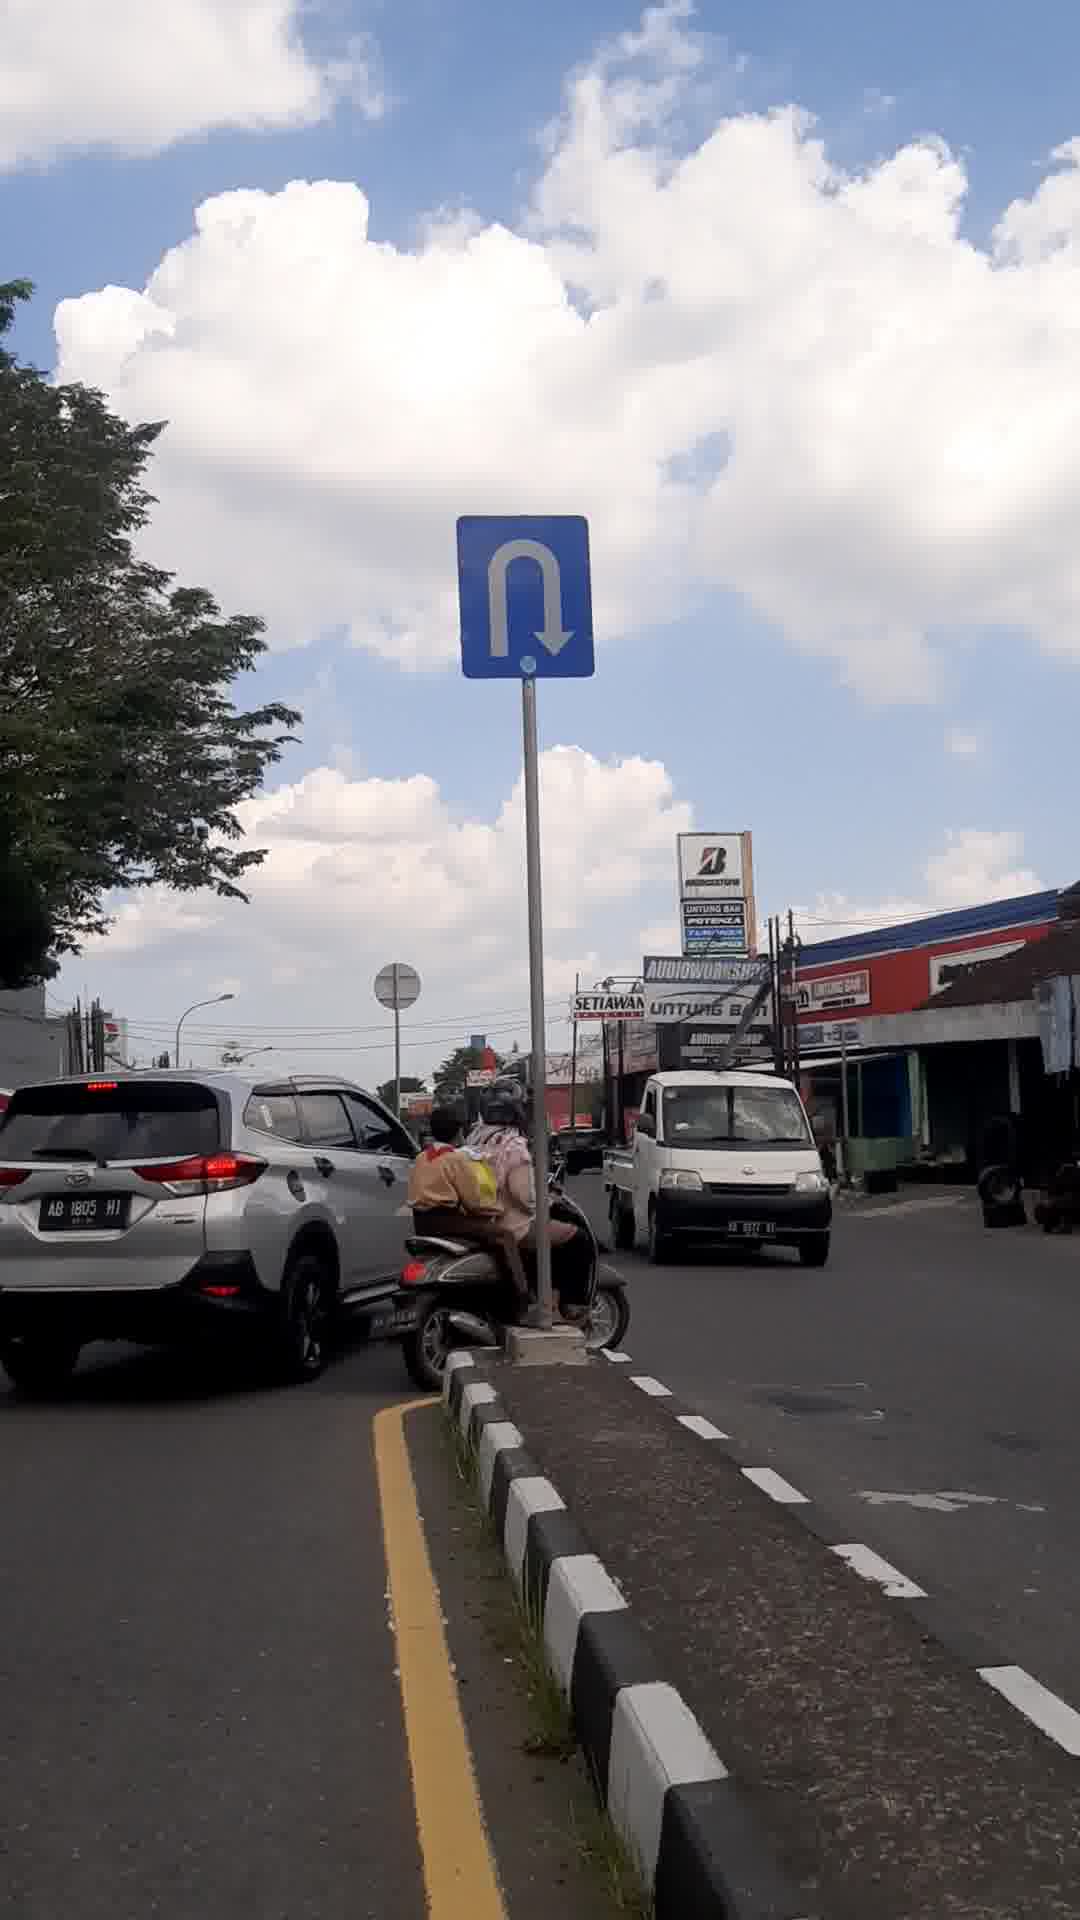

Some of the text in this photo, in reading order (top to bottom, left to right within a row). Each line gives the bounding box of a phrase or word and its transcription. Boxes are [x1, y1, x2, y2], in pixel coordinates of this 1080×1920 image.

[575, 996, 644, 1010] SETIAWAN
[48, 1200, 65, 1217] AB
[71, 1200, 97, 1217] 1805
